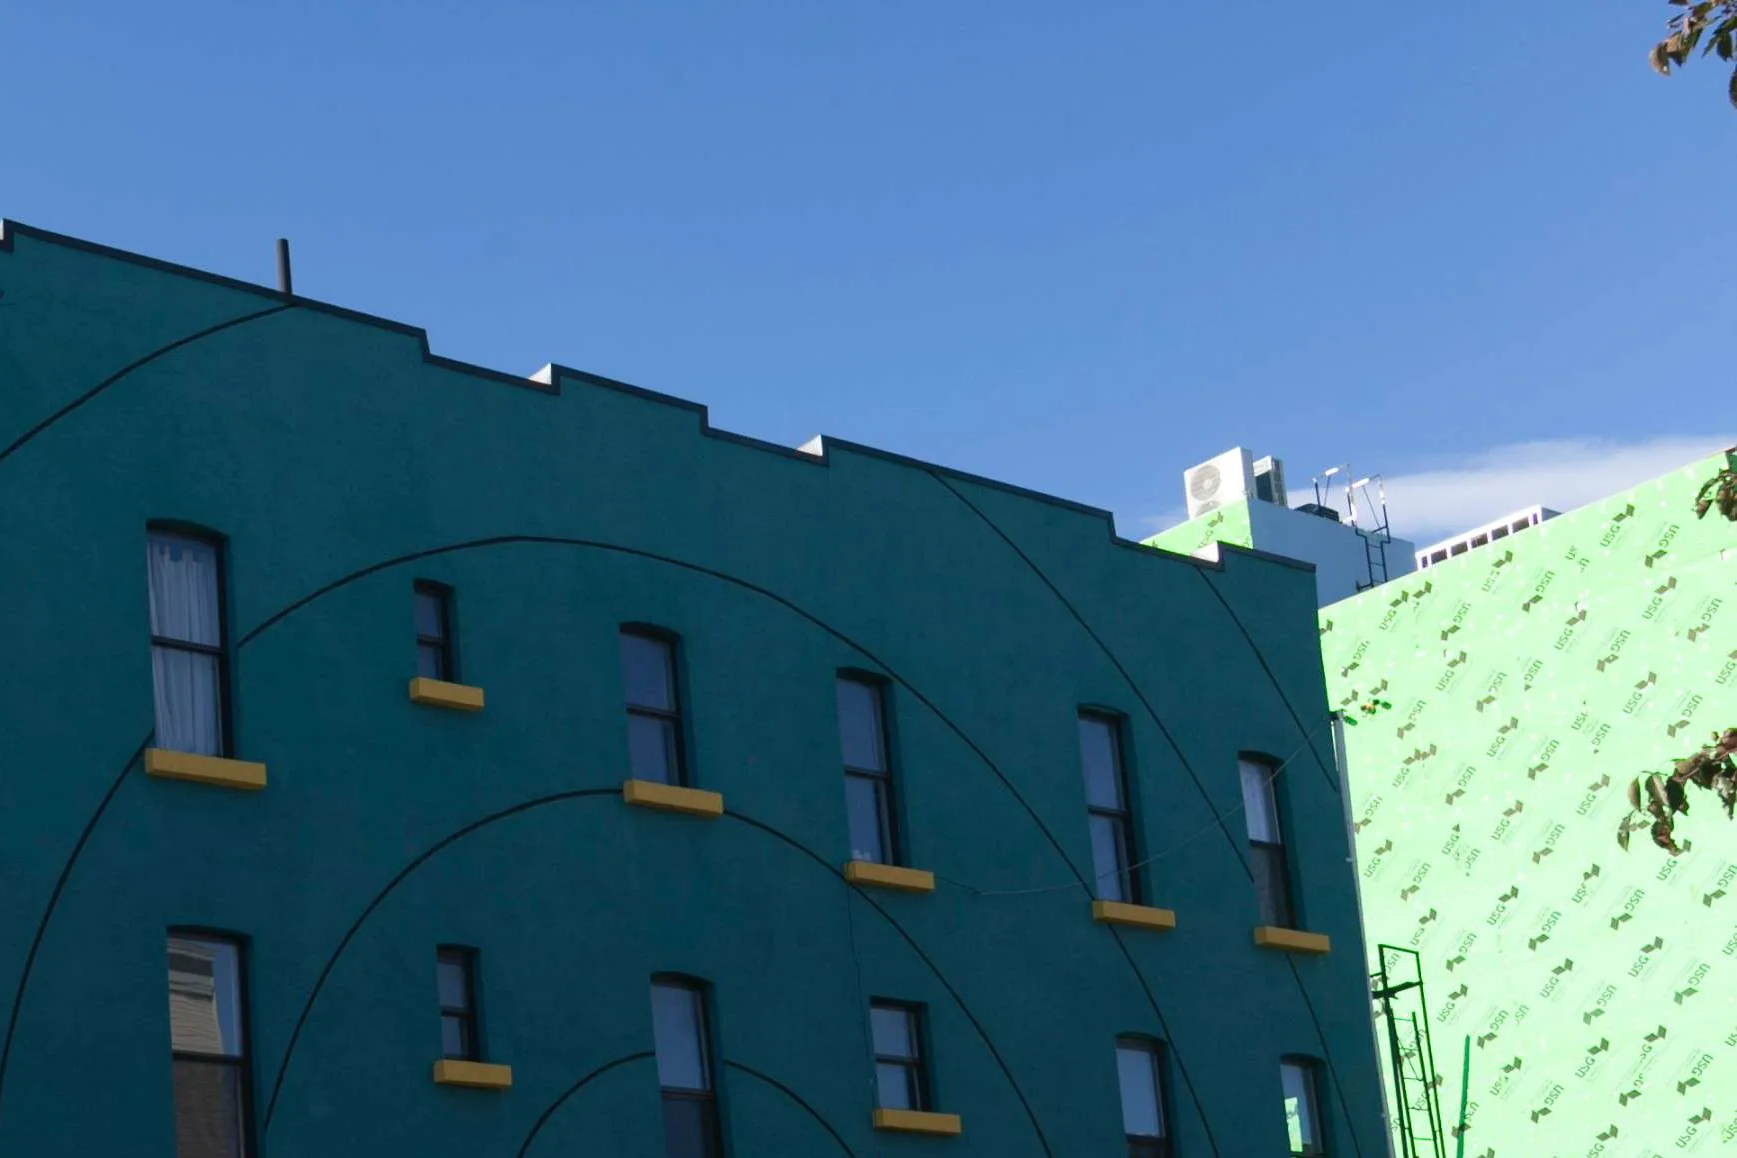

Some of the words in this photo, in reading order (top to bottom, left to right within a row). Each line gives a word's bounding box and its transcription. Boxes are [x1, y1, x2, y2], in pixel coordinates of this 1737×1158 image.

[1600, 524, 1620, 547] USG
[1659, 524, 1679, 548] USG
[1535, 570, 1555, 592] USG
[1453, 602, 1471, 624] USG
[1642, 598, 1663, 619] USG
[1701, 597, 1723, 622] USG
[1379, 610, 1397, 630] USG
[1554, 628, 1574, 650] USG
[1610, 629, 1631, 652] USG
[1436, 670, 1455, 691] USG
[1524, 659, 1543, 682] USG
[1715, 661, 1736, 685] USG
[1623, 691, 1643, 715] USG
[1681, 694, 1703, 717] USG
[1487, 736, 1505, 758] USG
[1541, 739, 1560, 762] USG
[1393, 767, 1410, 788] USG
[1459, 766, 1476, 787] USG
[1576, 793, 1597, 816] USG
[1491, 819, 1510, 840] USG
[1546, 824, 1566, 846] USG
[1442, 835, 1460, 855] USG
[1364, 858, 1381, 878] USG
[1413, 863, 1432, 884] USG
[1656, 858, 1678, 882] USG
[1624, 888, 1646, 912] USG
[1487, 905, 1506, 926] USG
[1541, 911, 1562, 932] USG
[1628, 955, 1650, 978] USG
[1688, 963, 1711, 986] USG
[1540, 977, 1559, 999] USG
[1596, 984, 1617, 1007] USG
[1436, 1002, 1455, 1024] USG
[1490, 1009, 1510, 1031] USG
[1575, 1057, 1596, 1078] USG
[1691, 1054, 1714, 1076] USG
[1544, 1084, 1564, 1106] USG
[1675, 1126, 1698, 1148] USG
